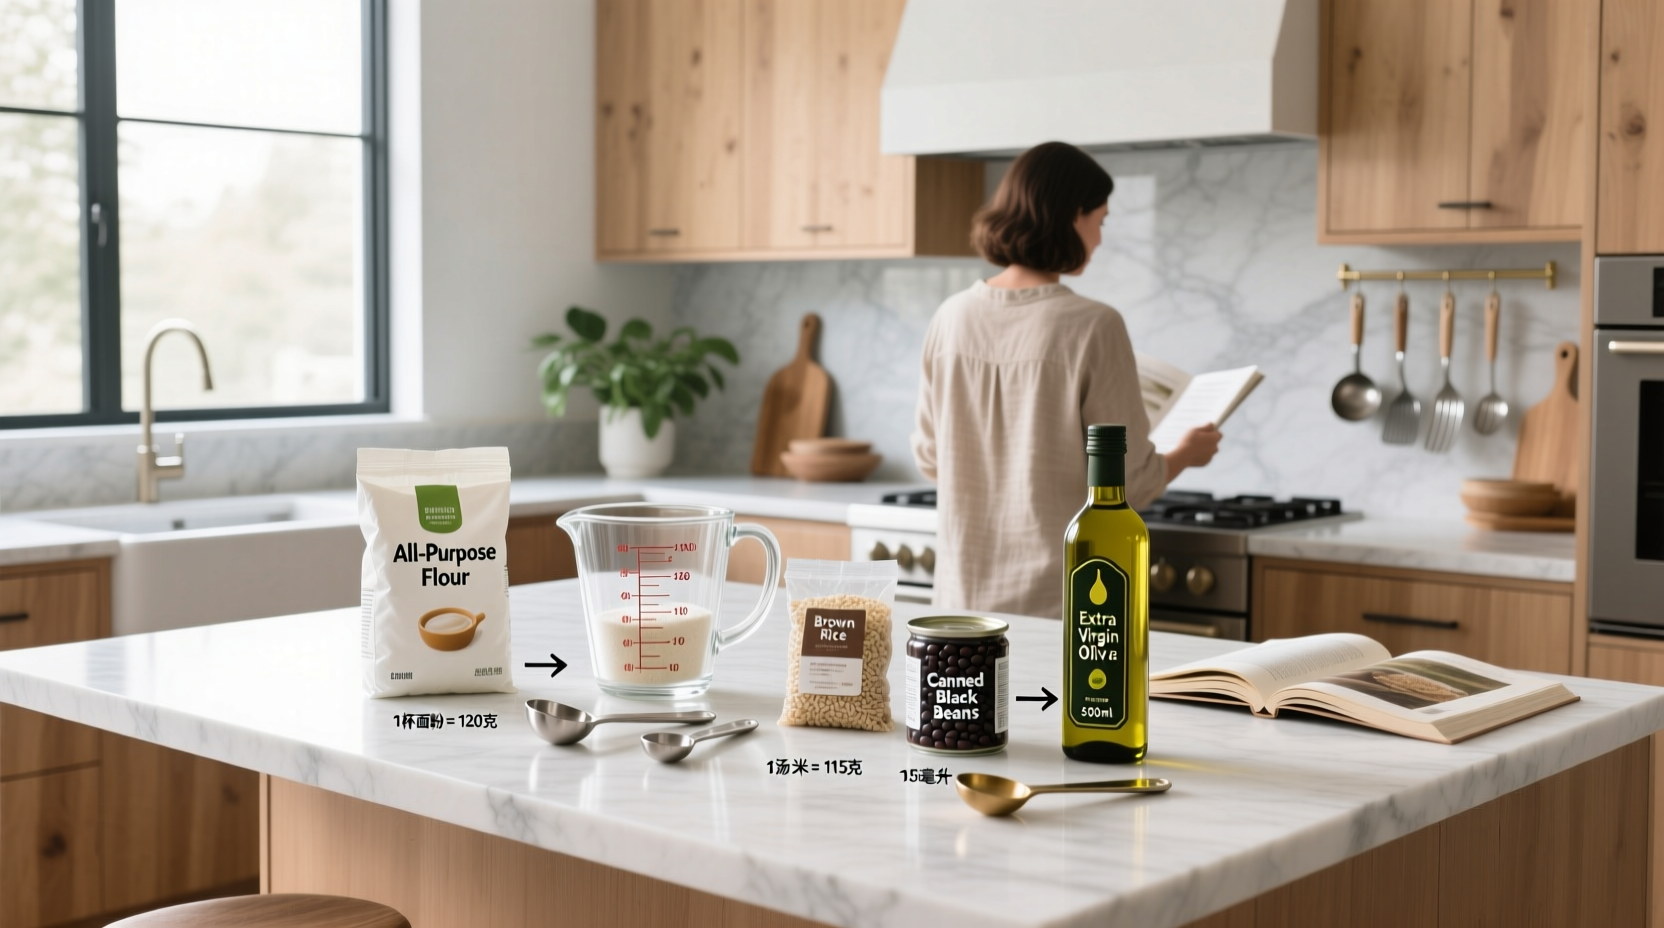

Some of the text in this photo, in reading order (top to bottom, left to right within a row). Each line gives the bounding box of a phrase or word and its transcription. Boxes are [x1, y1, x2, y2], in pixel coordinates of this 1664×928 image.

[393, 542, 497, 567] All-Purpose
[421, 567, 471, 587] Flour
[1079, 610, 1117, 627] Extra
[1078, 627, 1119, 648] Virgin
[926, 671, 985, 688] Canned
[936, 689, 978, 705] Black
[933, 704, 980, 720] Beans
[1081, 706, 1113, 718] 500ml
